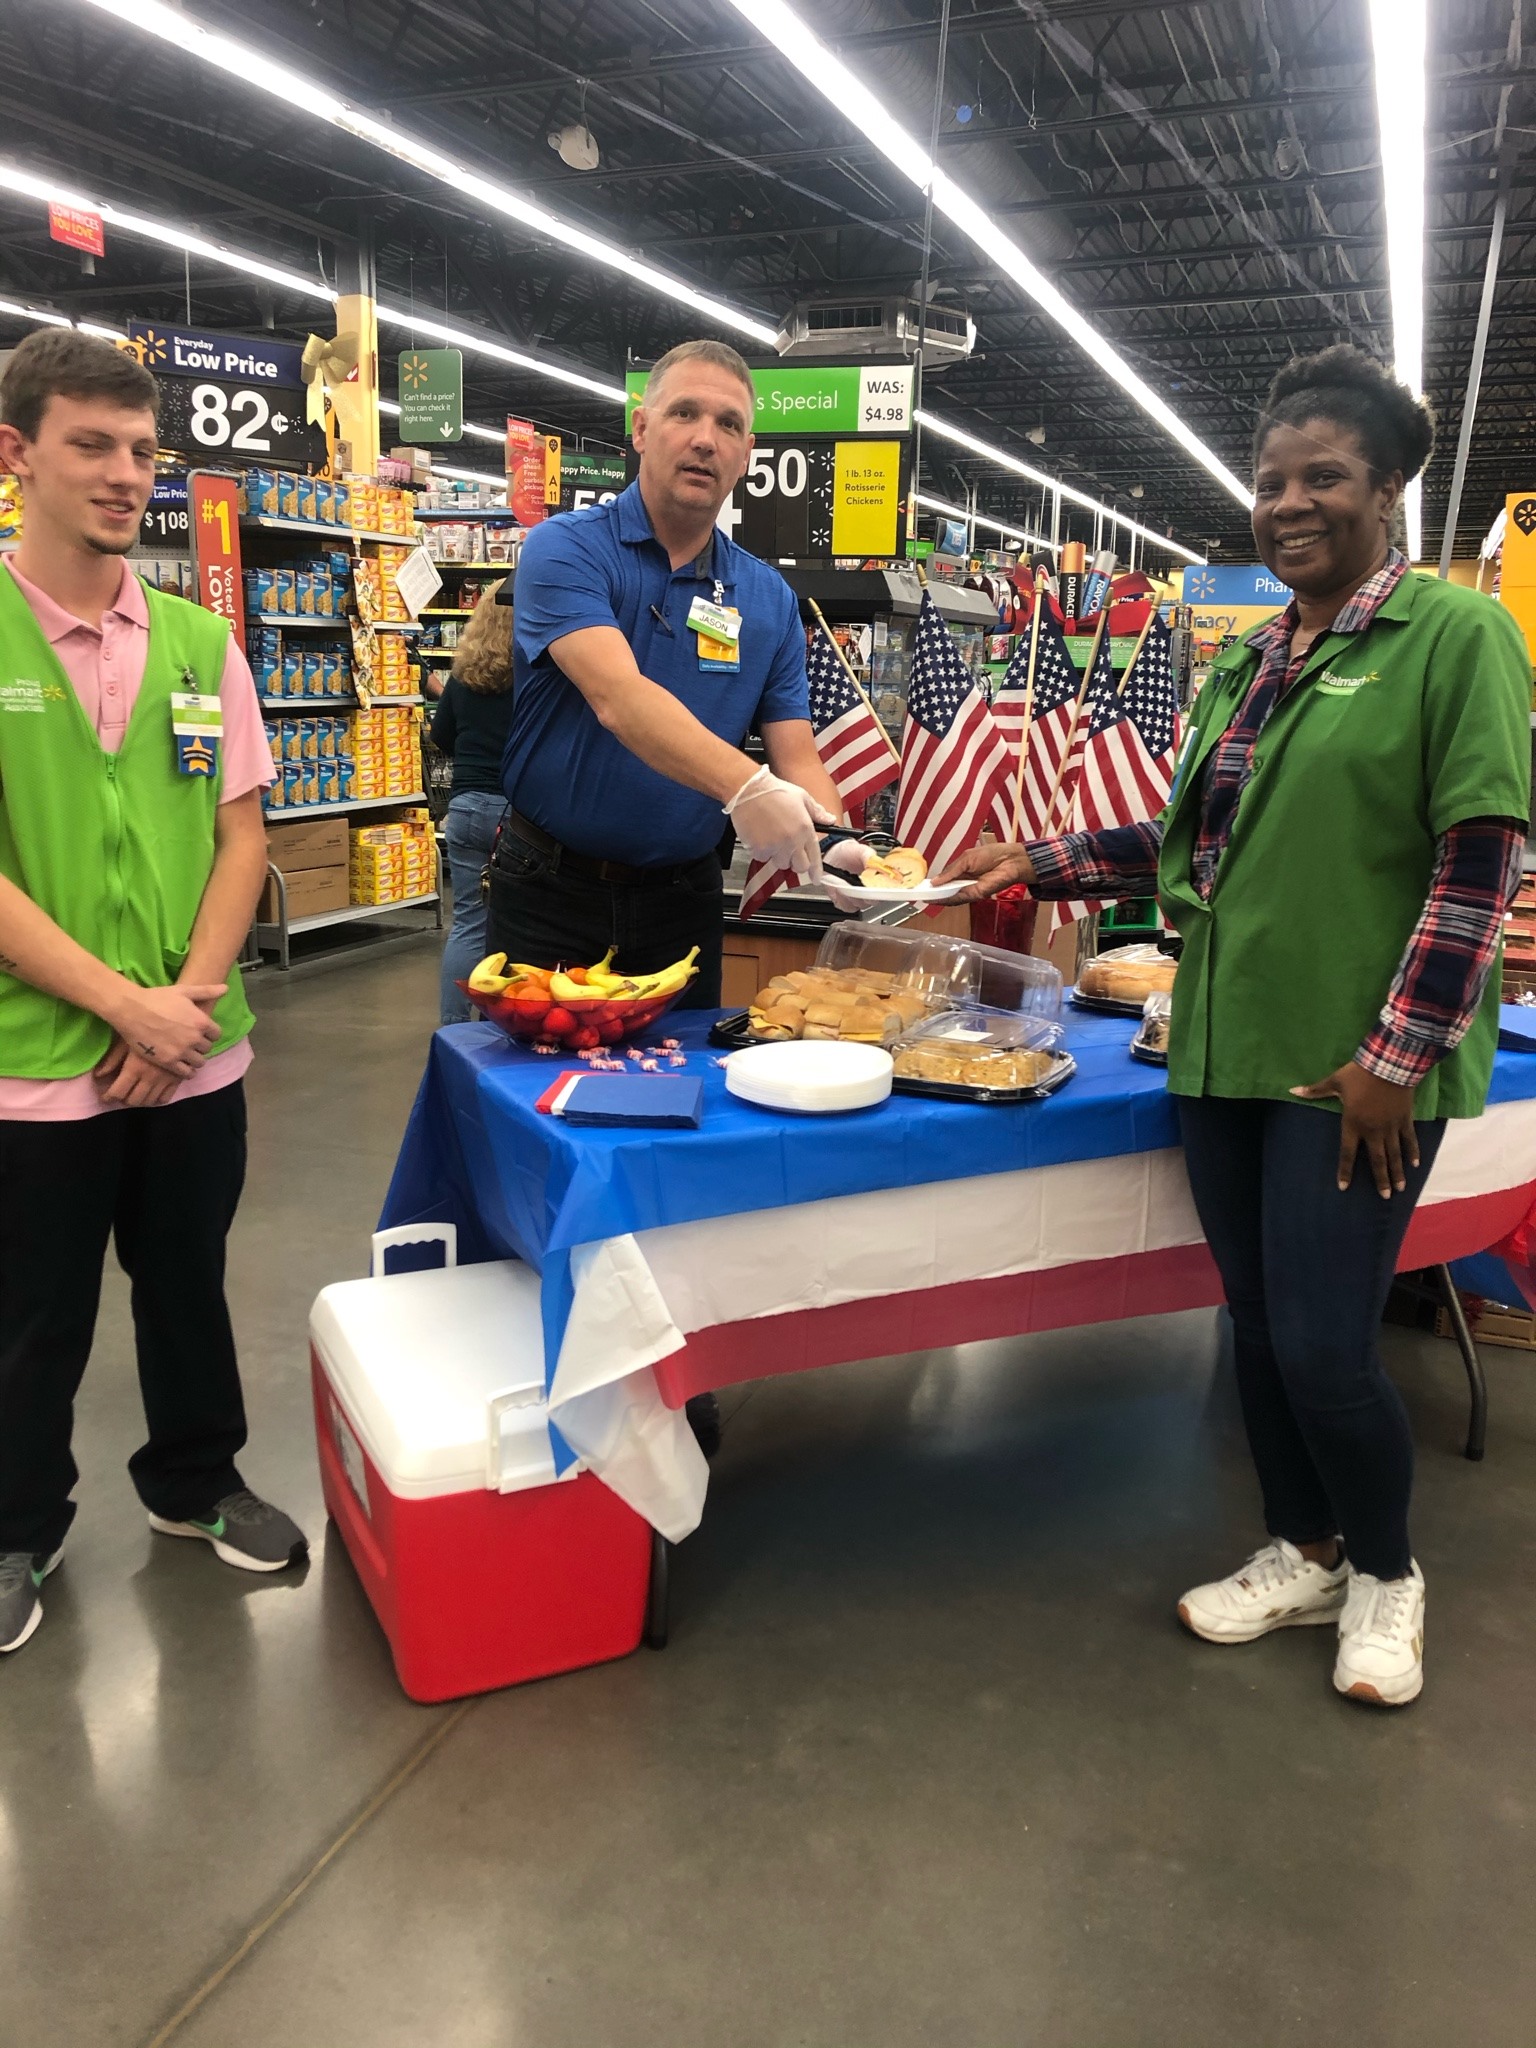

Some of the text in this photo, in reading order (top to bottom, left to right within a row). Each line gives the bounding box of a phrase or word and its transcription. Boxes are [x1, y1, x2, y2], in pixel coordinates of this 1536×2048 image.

[52, 216, 70, 232] YOU
[71, 210, 99, 231] PRICES
[173, 336, 214, 351] Everyday
[174, 346, 278, 378] Low Price
[867, 380, 904, 394] WAS:
[404, 393, 419, 401] Can't
[420, 393, 432, 401] find
[438, 393, 455, 402] price?
[771, 390, 838, 416] Special
[404, 404, 416, 412] You
[865, 406, 903, 424] $4.98
[404, 415, 418, 424] right
[523, 456, 541, 464] Order
[560, 466, 625, 480] appy Price. Happy
[851, 469, 861, 478] lb.
[863, 469, 872, 478] 13
[548, 475, 557, 487] A
[844, 482, 886, 492] Rotisserie
[153, 489, 170, 499] Low
[549, 491, 557, 502] 11
[846, 496, 884, 505] Chickens
[202, 499, 231, 554] #1
[223, 566, 236, 614] Voted
[698, 614, 728, 632] JASON
[1320, 670, 1366, 687] Walmart
[0, 686, 44, 699] almart
